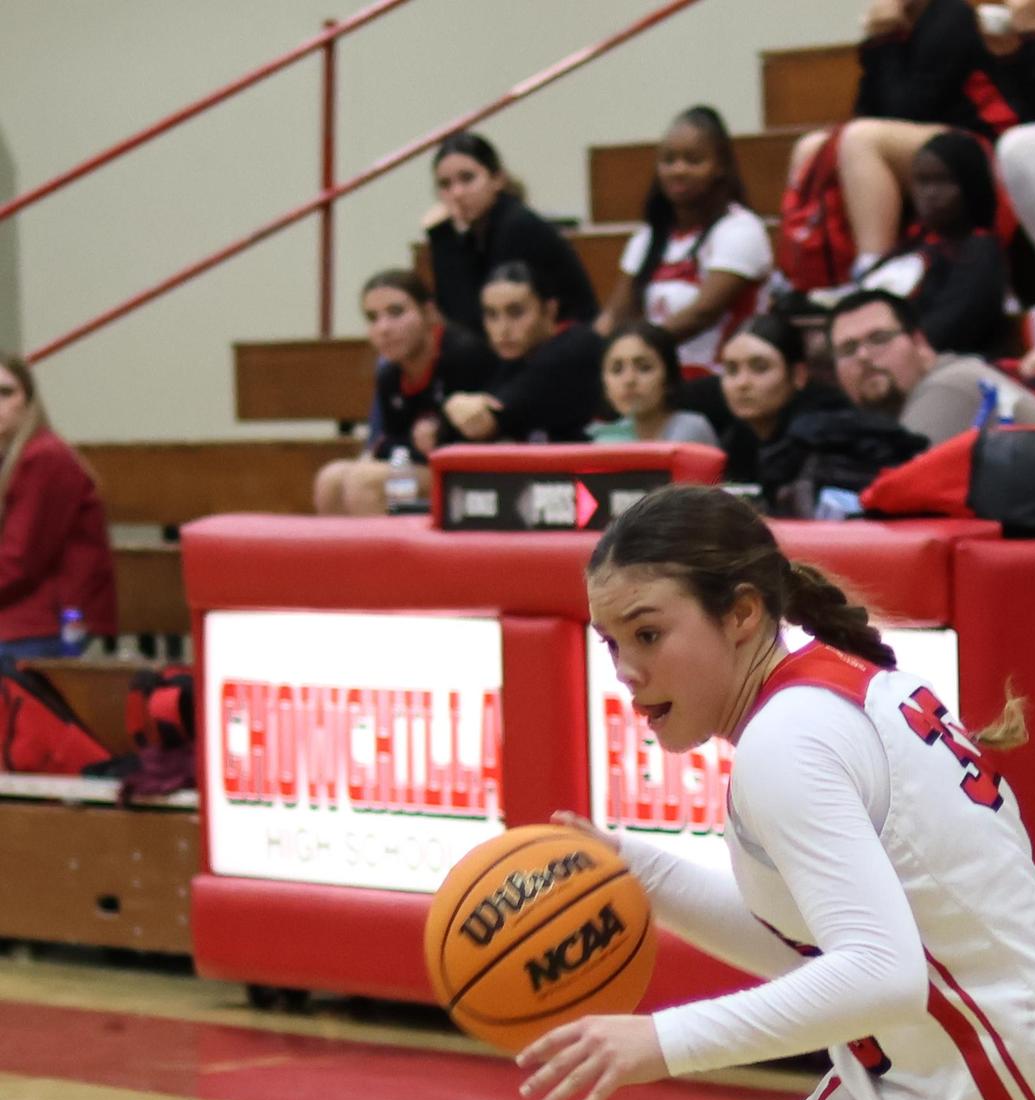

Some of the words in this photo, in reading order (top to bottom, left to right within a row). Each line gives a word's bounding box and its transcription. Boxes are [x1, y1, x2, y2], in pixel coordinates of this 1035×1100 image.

[222, 678, 504, 821] CHOWCHILLA
[460, 851, 597, 946] Wilson
[524, 902, 626, 993] NCAA
